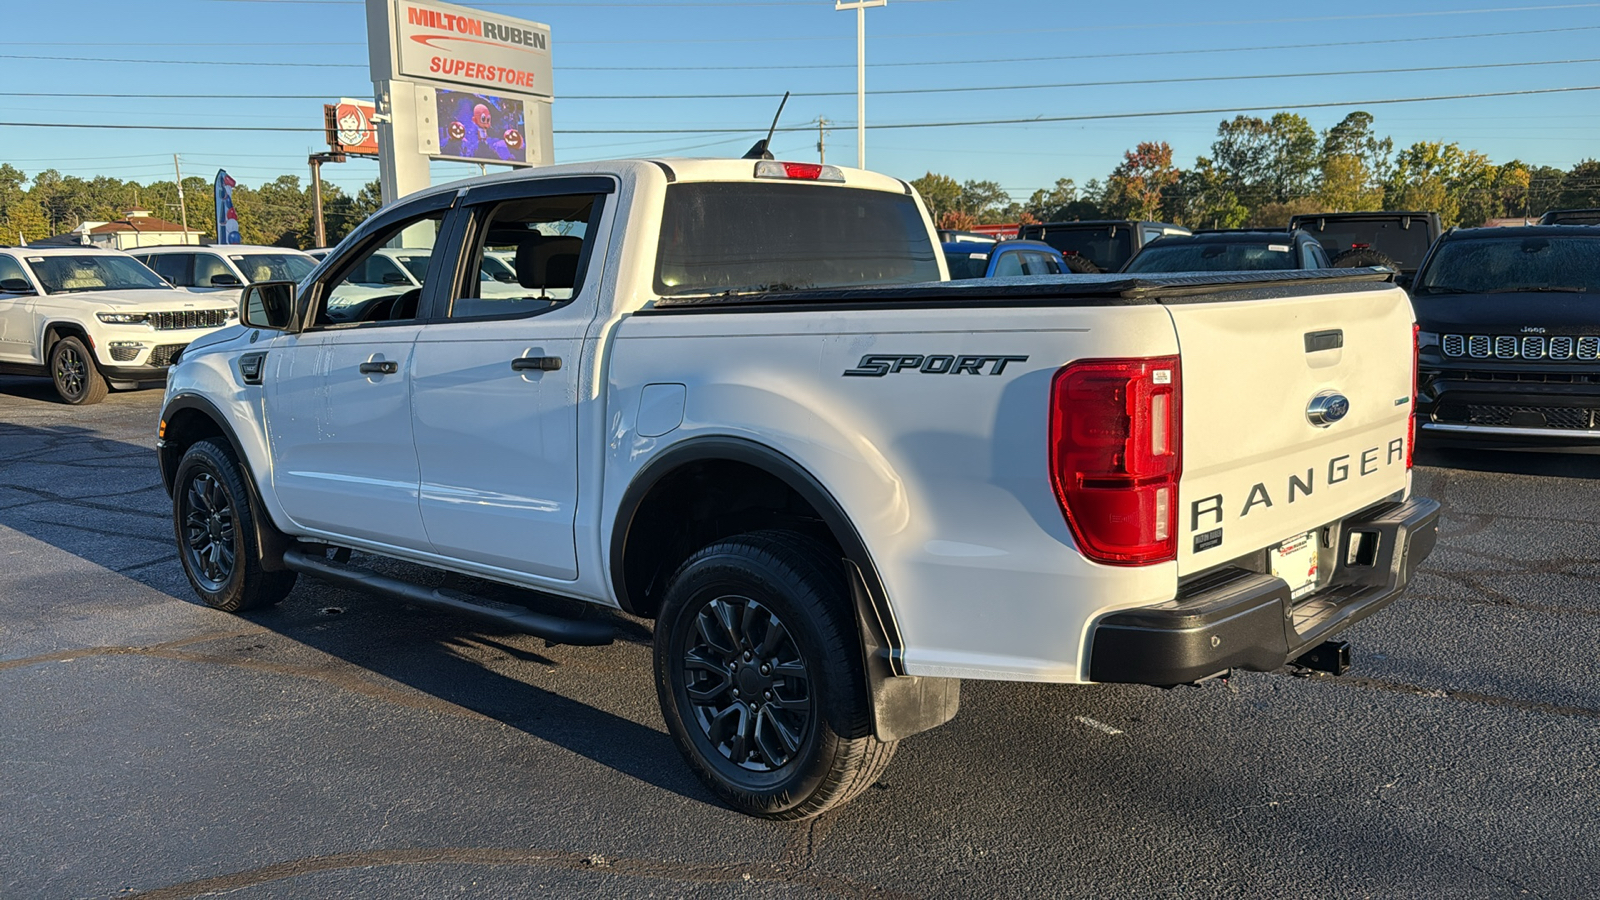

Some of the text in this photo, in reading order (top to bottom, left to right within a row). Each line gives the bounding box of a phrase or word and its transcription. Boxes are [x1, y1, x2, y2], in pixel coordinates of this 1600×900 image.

[430, 56, 535, 88] SUPERSTORE
[842, 353, 1029, 377] SPORT
[1190, 437, 1403, 532] RANGER
